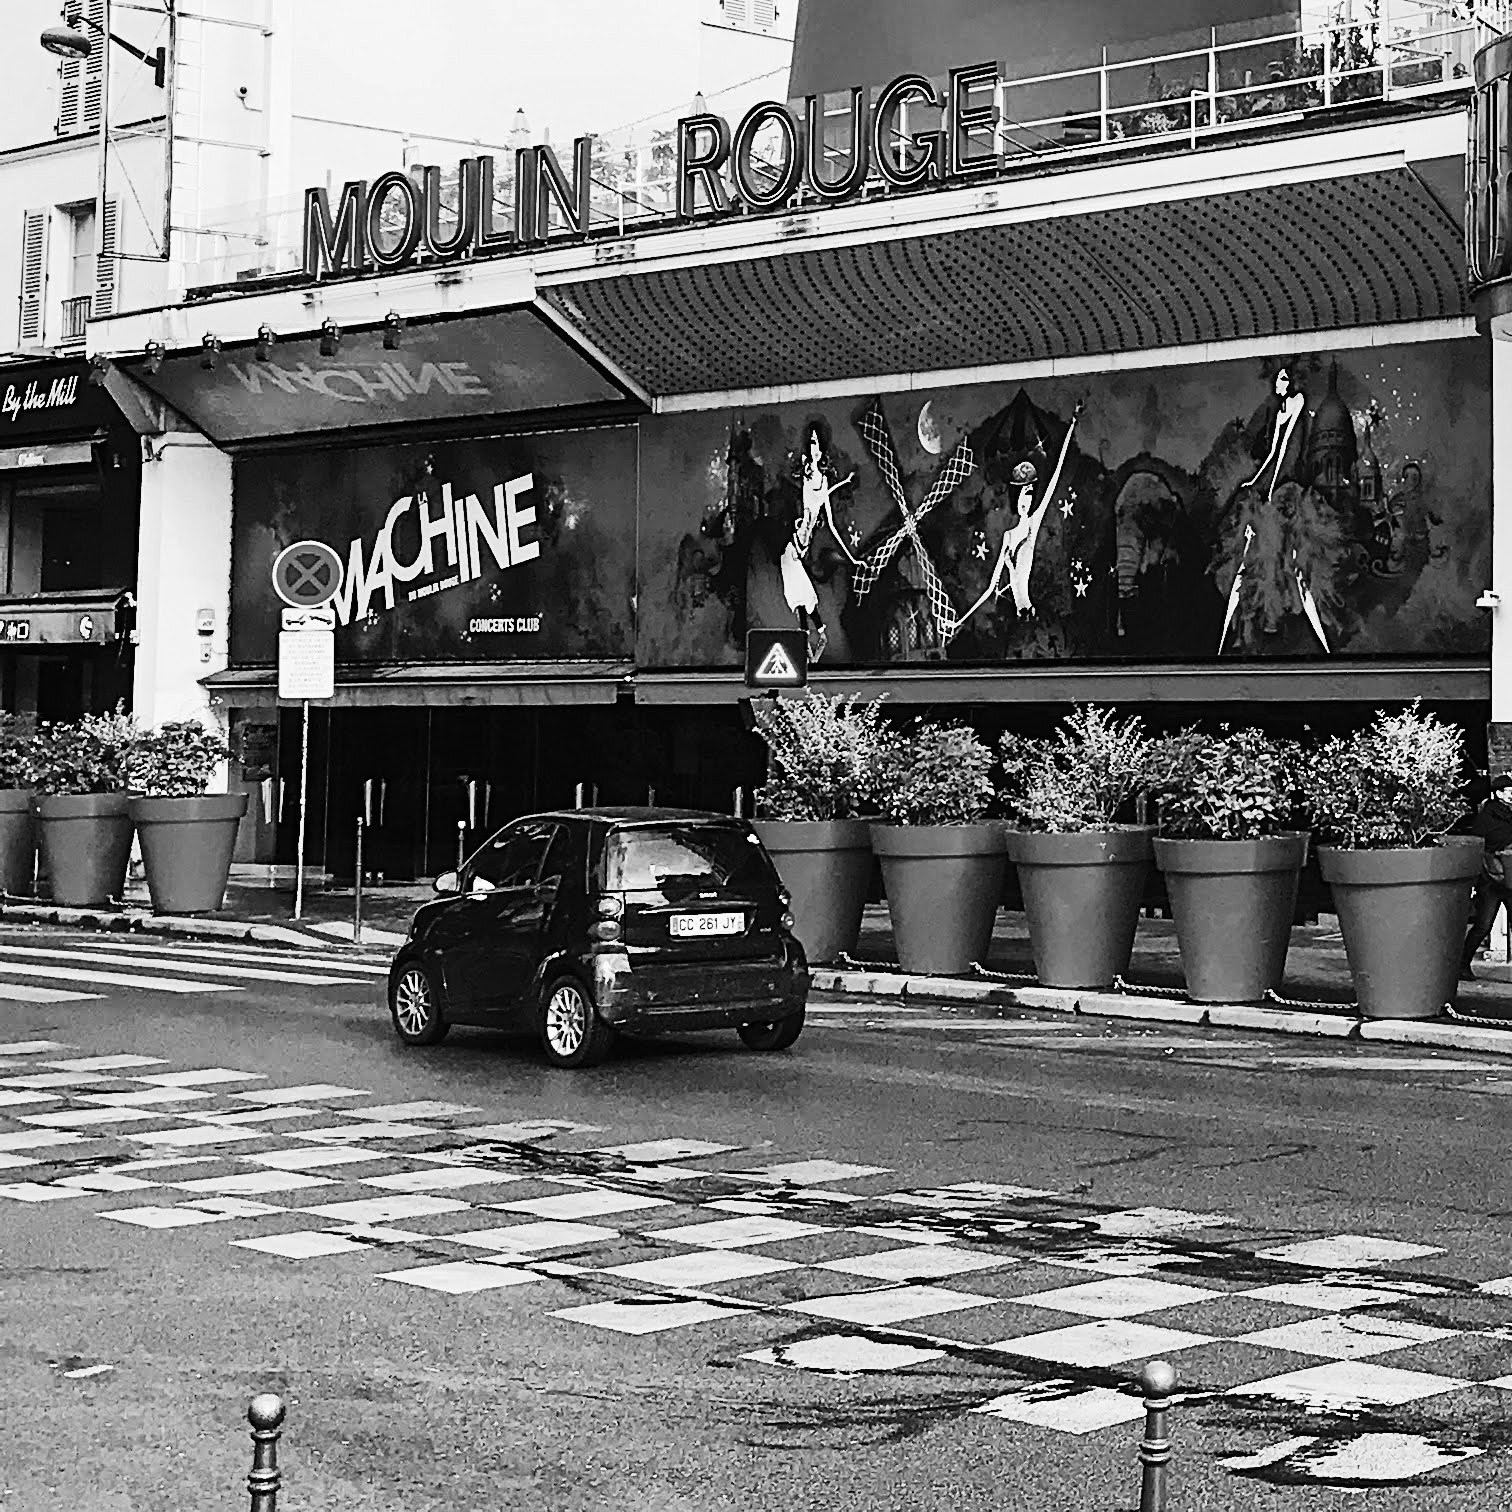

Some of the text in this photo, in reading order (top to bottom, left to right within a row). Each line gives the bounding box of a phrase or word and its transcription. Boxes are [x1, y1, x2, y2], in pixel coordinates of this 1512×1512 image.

[303, 61, 1004, 279] MOULIN ROUGE
[2, 375, 79, 422] By the Mill
[326, 473, 540, 626] MACHINE
[469, 617, 540, 633] CONCERTS CLUB
[679, 916, 736, 931] CC 261 JY
